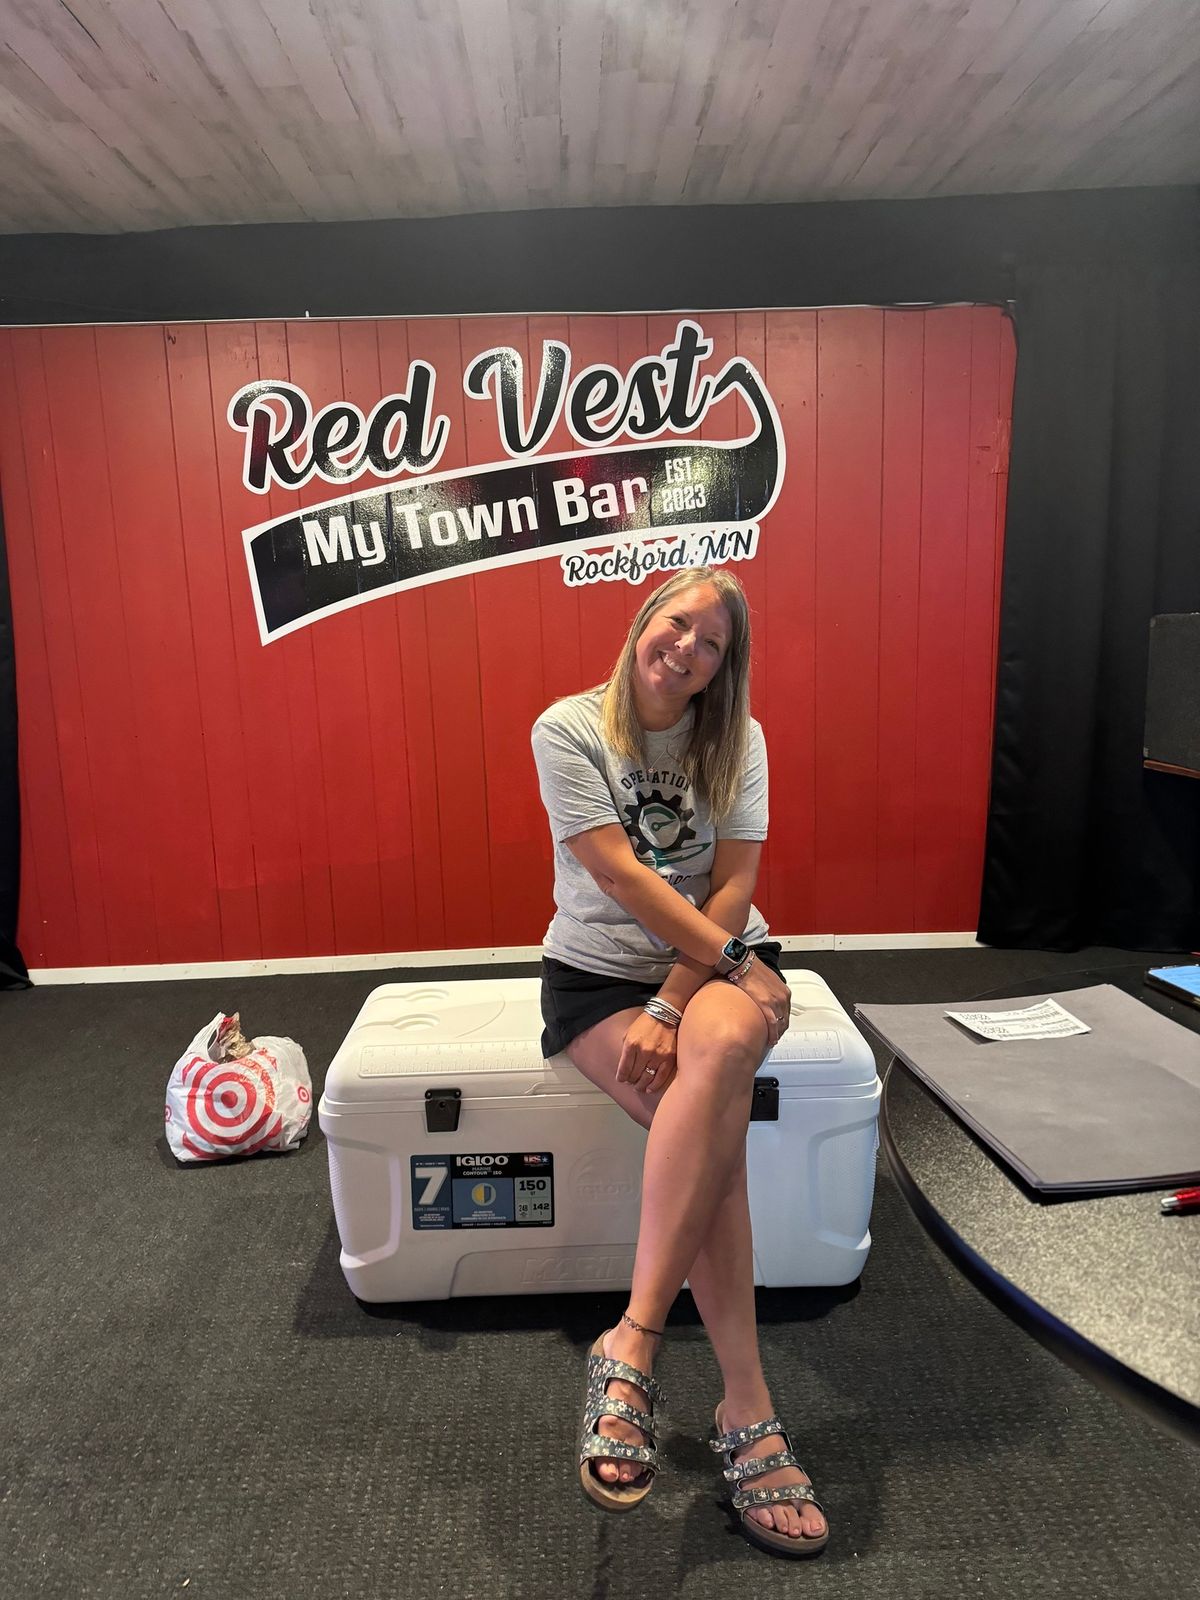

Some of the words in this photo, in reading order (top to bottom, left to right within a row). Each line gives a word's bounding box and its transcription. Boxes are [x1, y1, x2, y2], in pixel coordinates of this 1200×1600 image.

[232, 363, 446, 490] Red
[467, 325, 711, 453] Vest
[661, 483, 706, 513] 2023
[302, 515, 387, 567] My
[397, 495, 539, 549] Town
[552, 476, 649, 526] Bar
[565, 539, 695, 584] Rockford,
[698, 529, 753, 566] MN
[456, 1155, 509, 1167] IGLOO
[415, 1166, 449, 1205] 7
[519, 1179, 547, 1191] 150
[532, 1202, 550, 1211] 142
